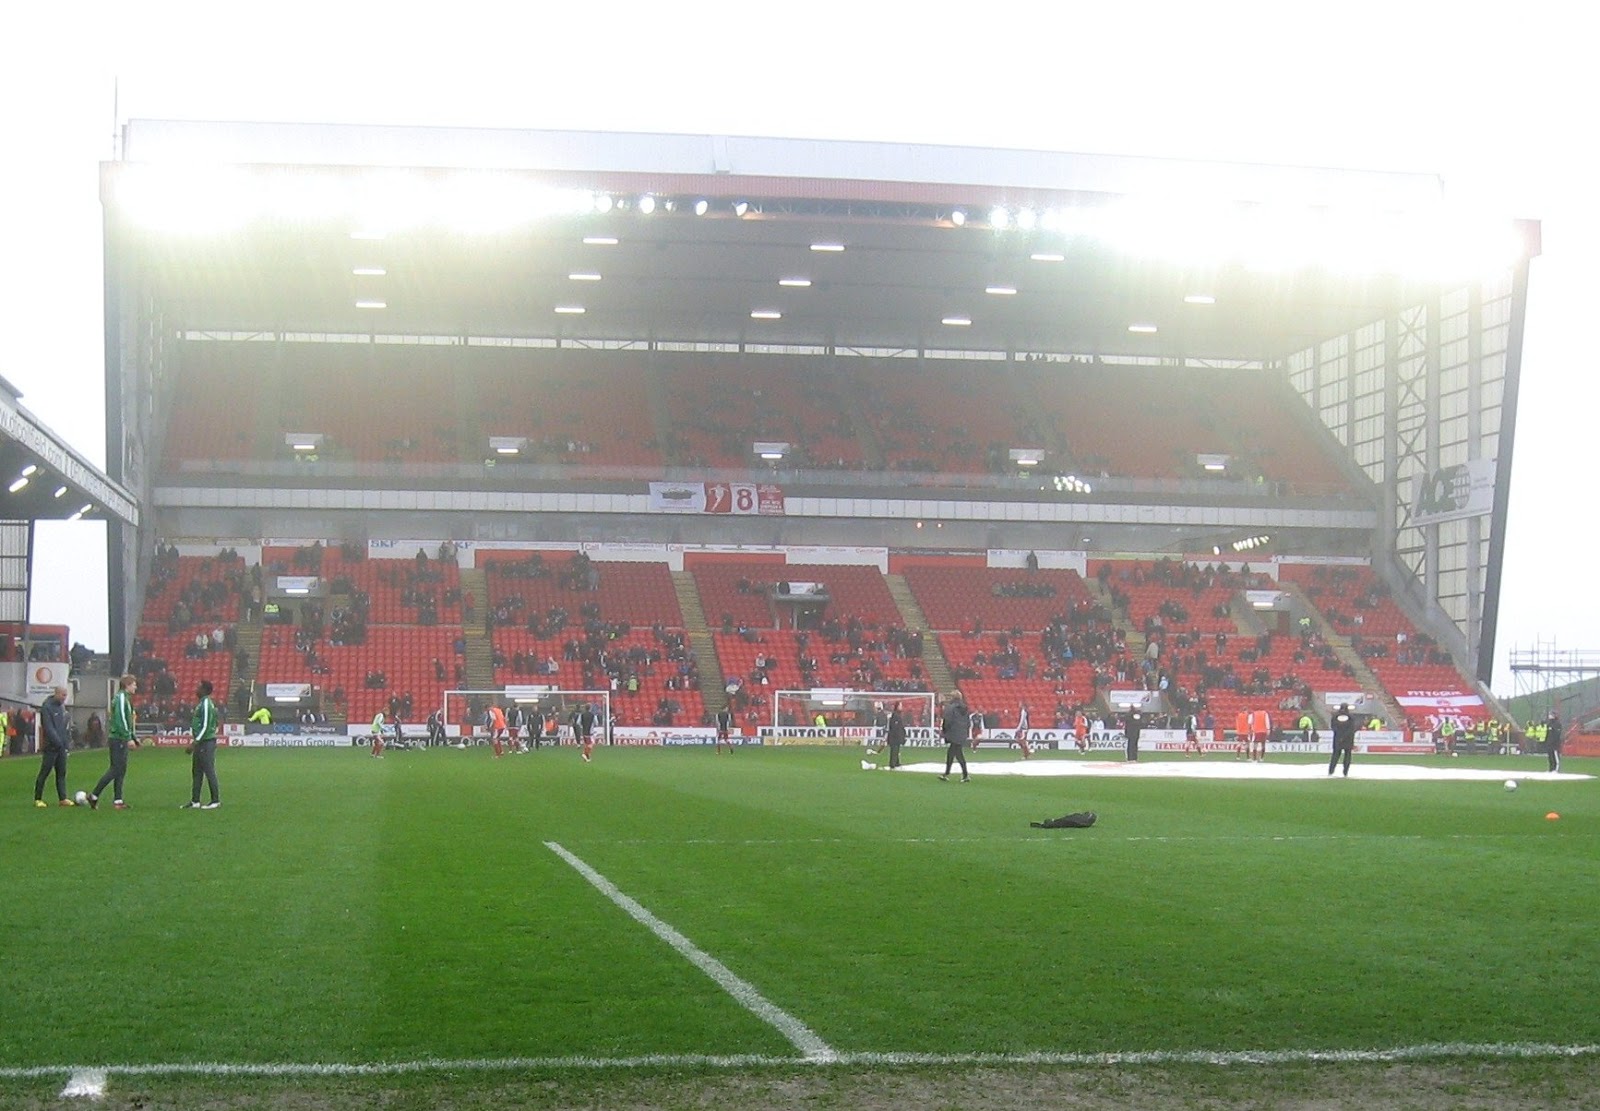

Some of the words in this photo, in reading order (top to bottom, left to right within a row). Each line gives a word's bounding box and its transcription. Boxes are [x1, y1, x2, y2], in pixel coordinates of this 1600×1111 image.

[737, 488, 753, 511] 8
[264, 737, 303, 747] Raeburn
[1271, 743, 1320, 752] SAFELIFT
